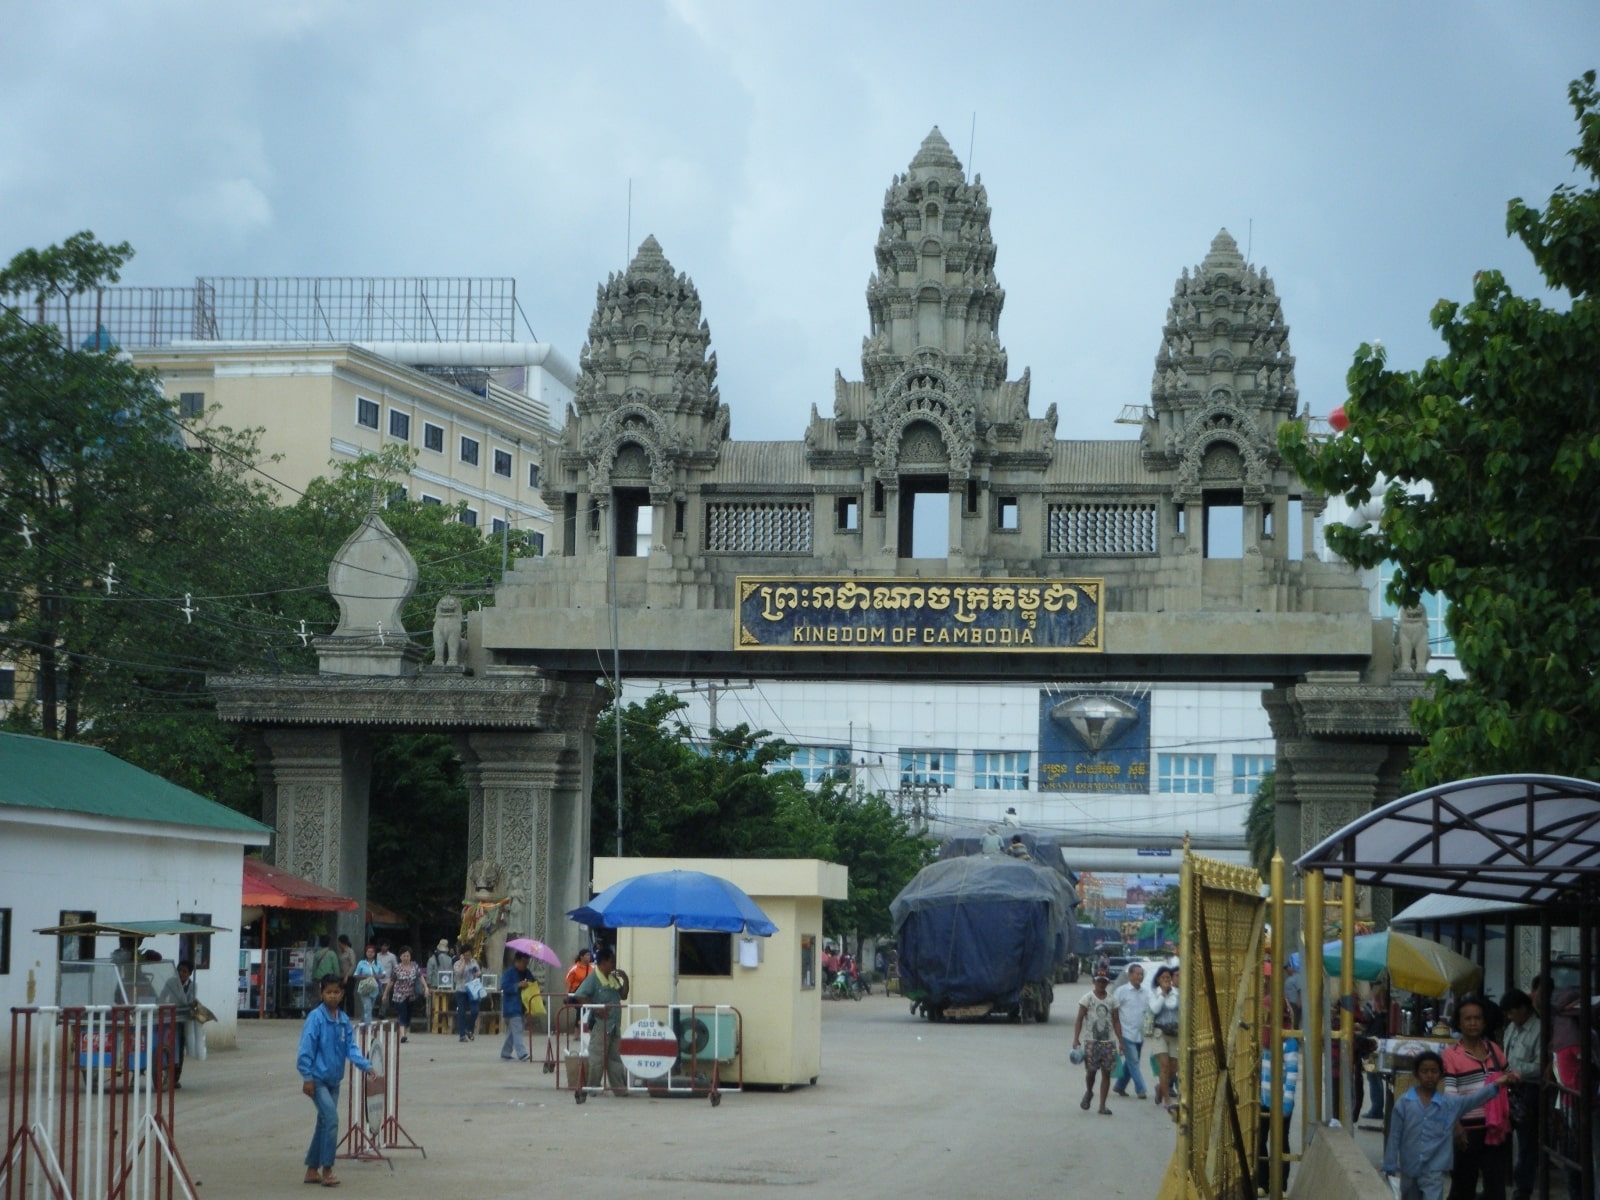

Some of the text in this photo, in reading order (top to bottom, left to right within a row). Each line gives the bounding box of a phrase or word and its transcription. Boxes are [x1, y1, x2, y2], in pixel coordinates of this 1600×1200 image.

[760, 582, 1078, 629] ព្រះរាជាណាចក្រកម្ពុជា
[793, 626, 1034, 644] KINGDOM OF CAMBODIA
[637, 1059, 662, 1067] STOP
